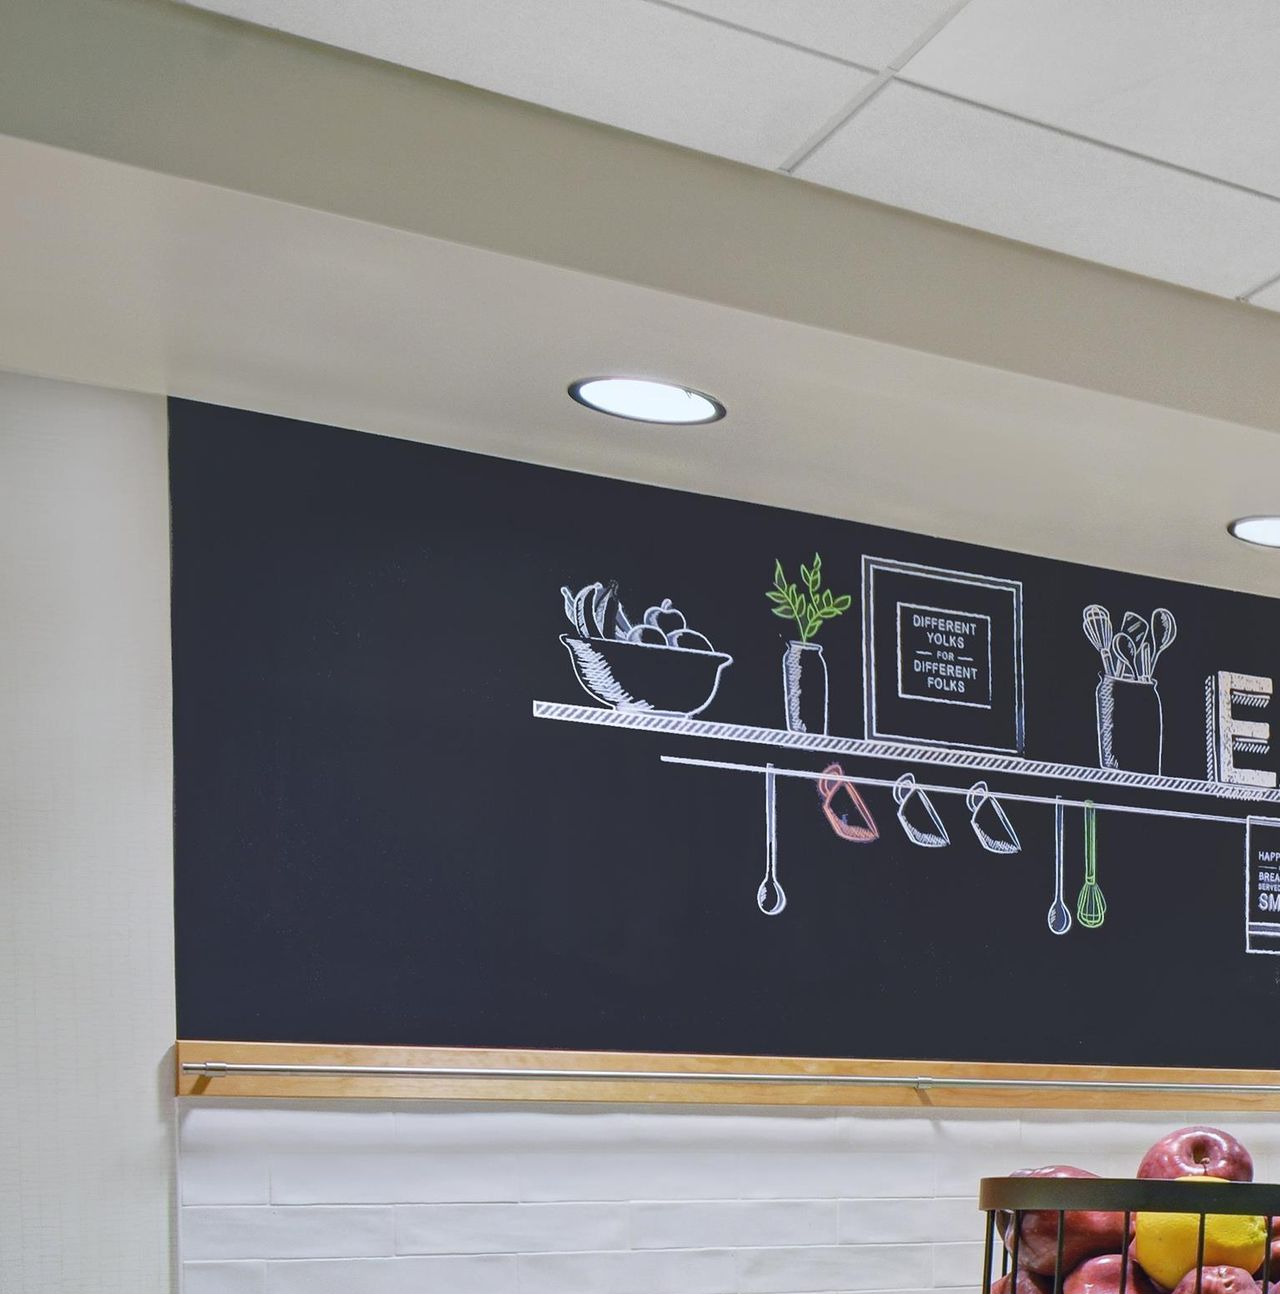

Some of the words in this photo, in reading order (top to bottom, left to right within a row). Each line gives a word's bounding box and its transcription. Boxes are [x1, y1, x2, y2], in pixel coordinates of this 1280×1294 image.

[913, 614, 976, 635] DIFFERENT
[927, 632, 964, 648] YOLKS
[937, 651, 954, 661] FOR
[914, 659, 977, 680] DIFFERENT
[927, 676, 965, 693] FOLKS
